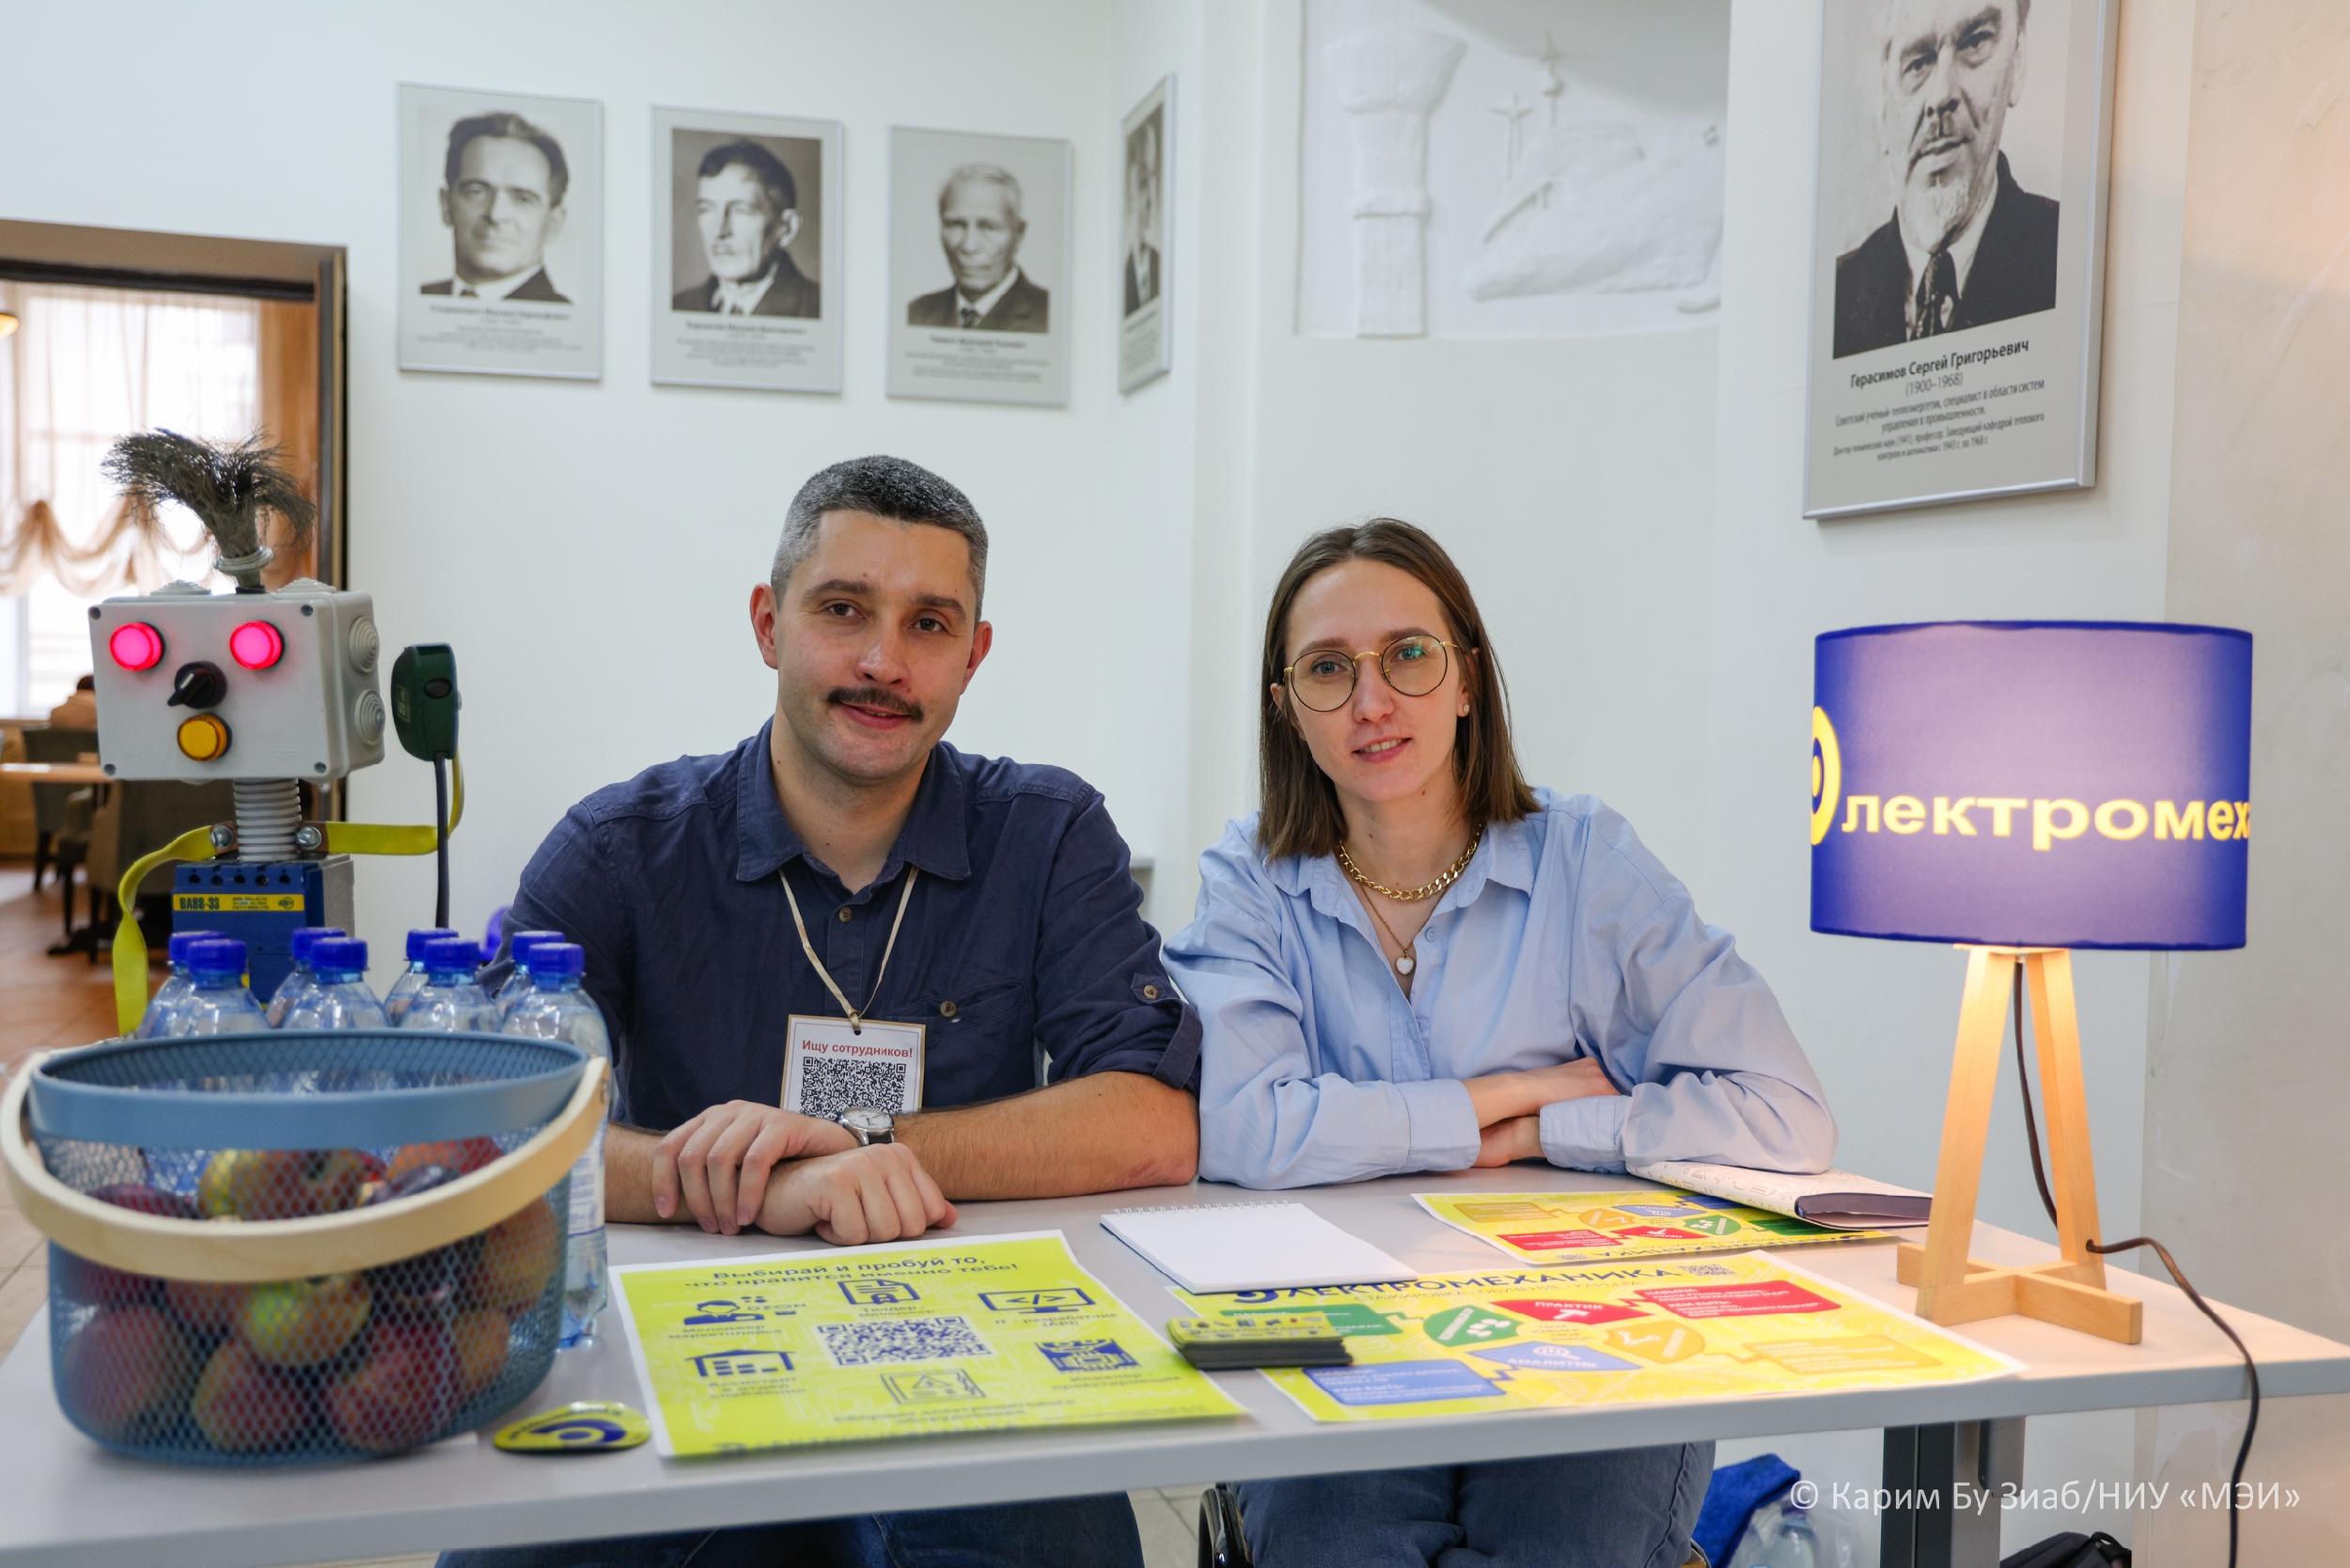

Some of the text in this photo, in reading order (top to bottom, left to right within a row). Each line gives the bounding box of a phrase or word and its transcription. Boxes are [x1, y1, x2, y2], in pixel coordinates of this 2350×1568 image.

[1850, 339, 2029, 388] Герасимов Сергей Григорьевич
[1943, 391, 1982, 406] специалист
[1989, 384, 2018, 398] области
[2018, 380, 2044, 392] систем
[1882, 417, 1919, 434] управления
[802, 1040, 913, 1058] Ищу сотрудников!
[713, 1265, 827, 1278] Выбирай
[857, 1257, 945, 1271] пробуй
[951, 1256, 985, 1265] то,
[736, 1273, 852, 1285] нравится
[860, 1267, 951, 1278] именно
[961, 1262, 1018, 1273] тебе!
[1534, 1300, 1604, 1310] ПРАКТИК
[682, 1325, 765, 1333] Менеджер
[1507, 1357, 1598, 1369] АНАЛИТИК
